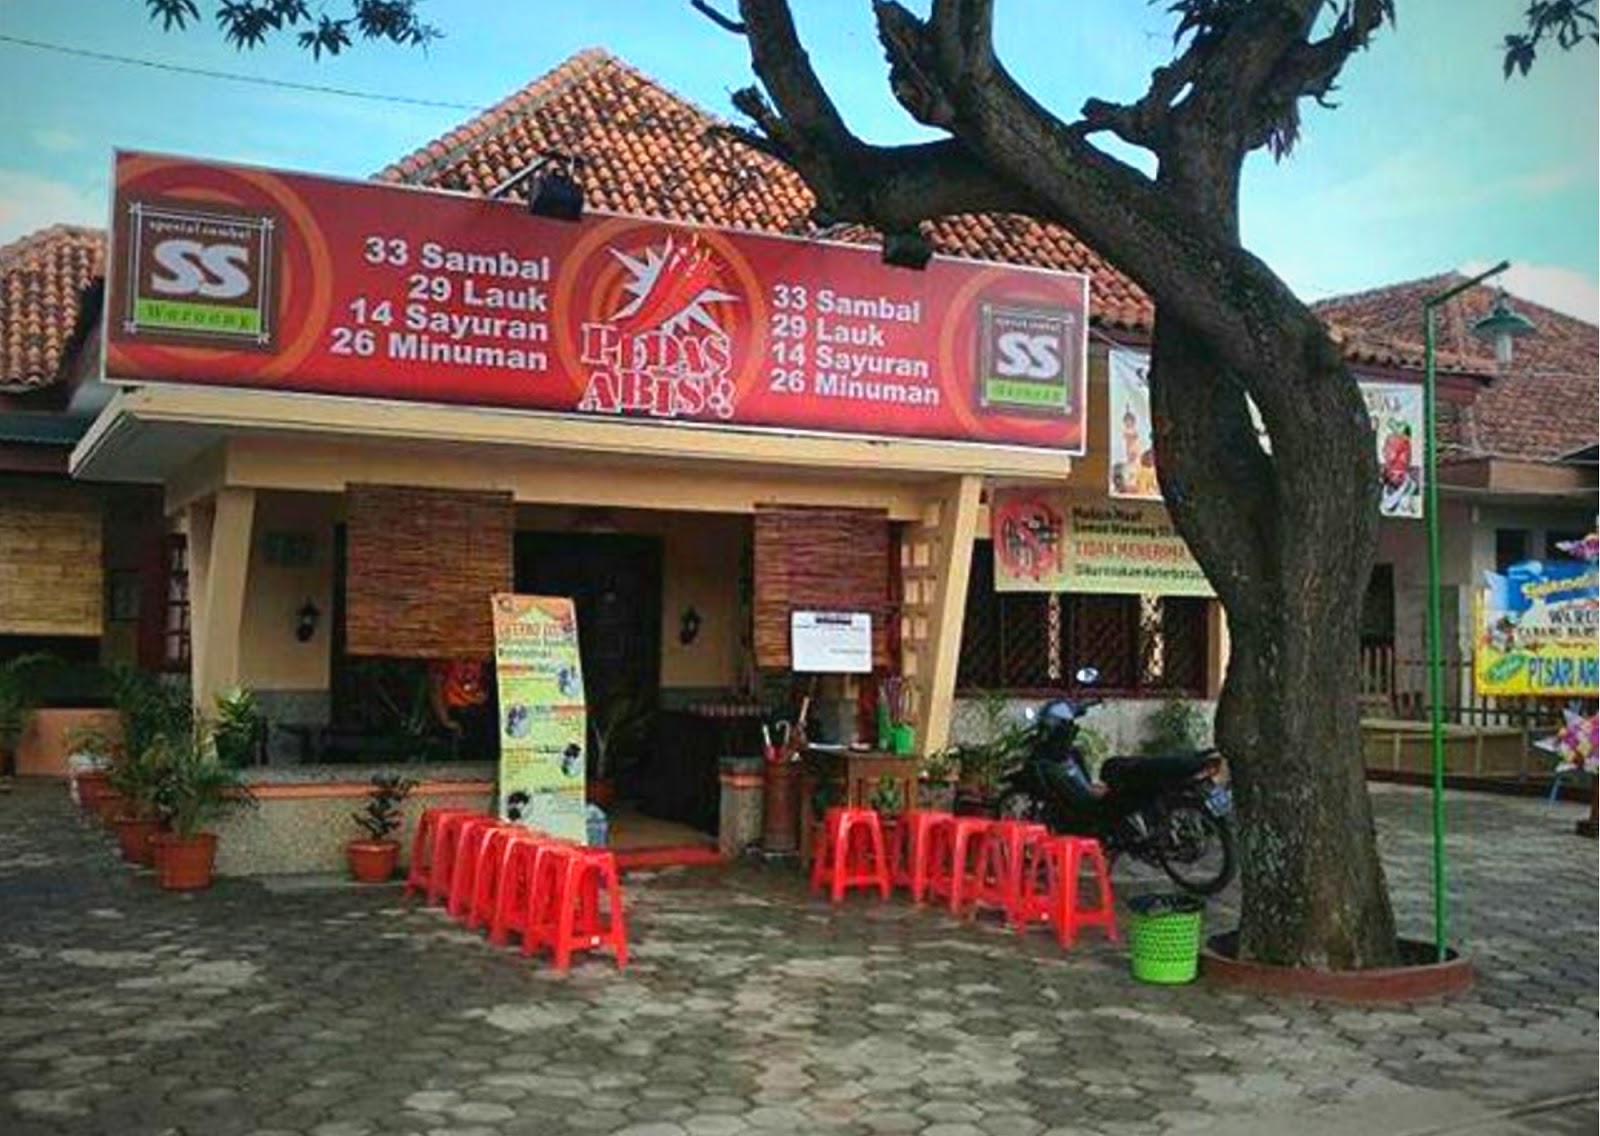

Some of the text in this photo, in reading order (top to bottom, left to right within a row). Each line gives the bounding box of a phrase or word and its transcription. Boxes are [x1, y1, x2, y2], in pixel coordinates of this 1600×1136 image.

[152, 239, 250, 298] SS
[365, 236, 549, 281] 33 Sambal
[408, 273, 548, 311] 29 Lauk
[772, 284, 921, 324] 33 Sambal
[350, 297, 548, 341] 14 Sayuran
[772, 312, 885, 347] 29 Lauk
[330, 326, 548, 371] 26 Minuman
[772, 341, 929, 378] 14 Sayuran
[997, 332, 1061, 379] SS
[770, 367, 940, 406] 26 Minuman
